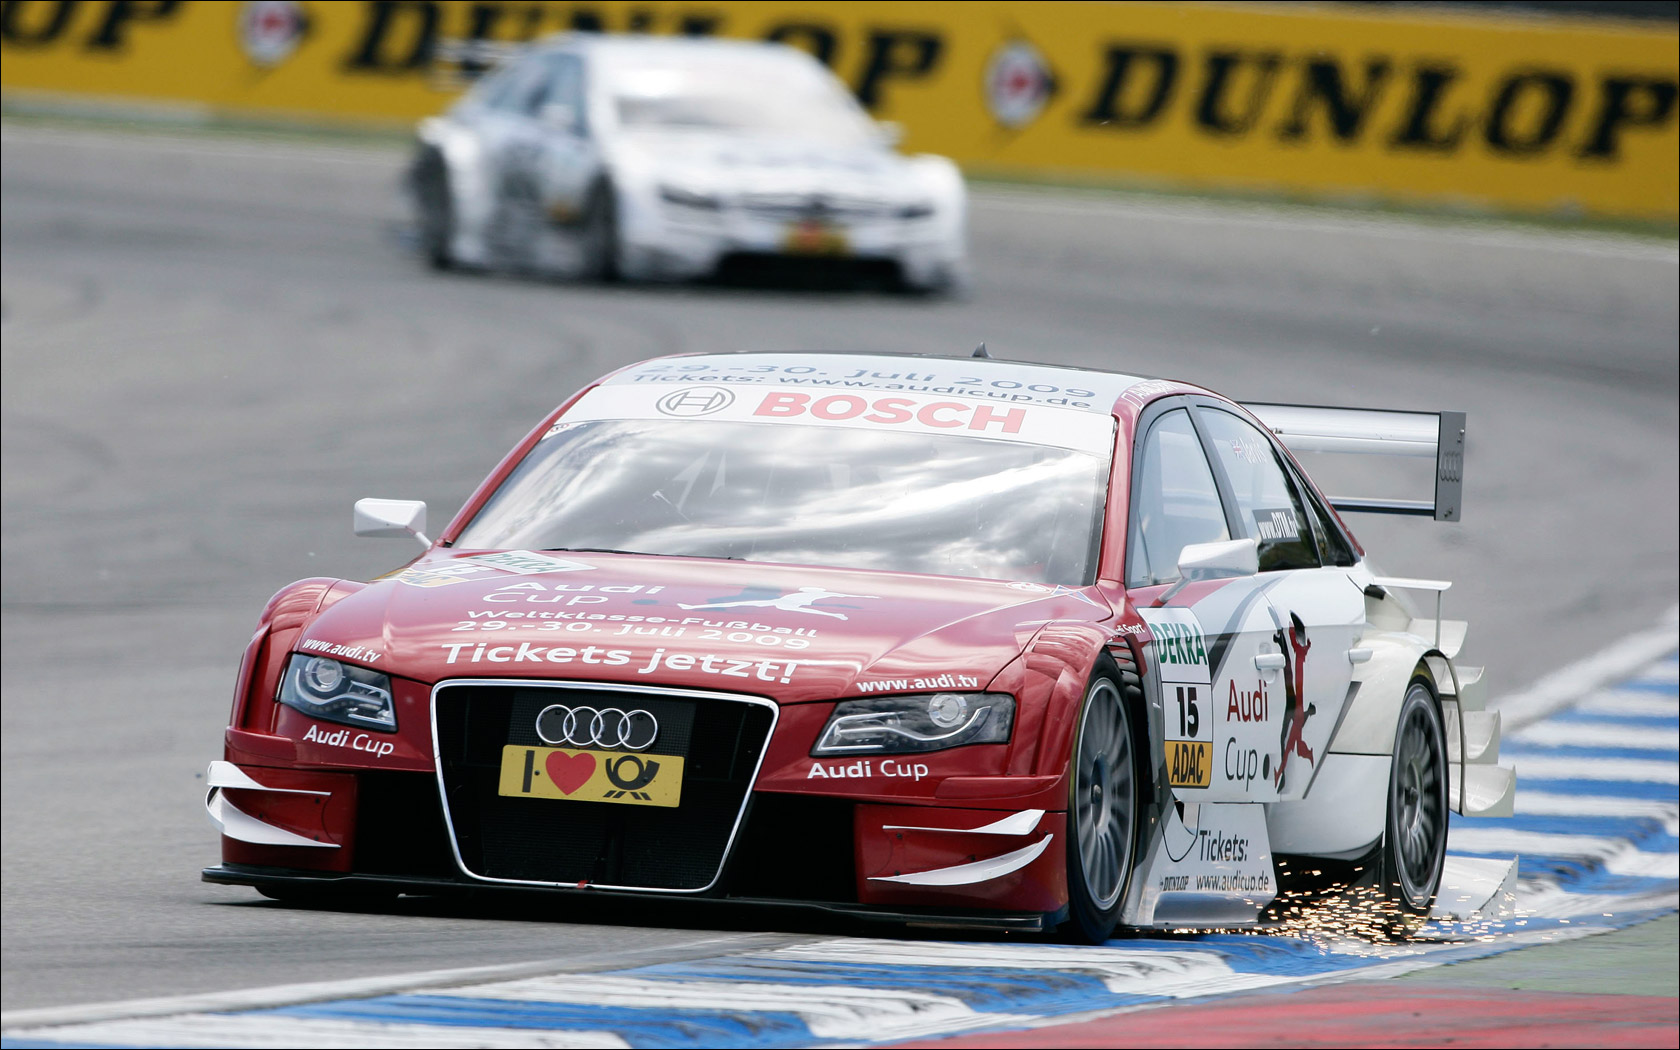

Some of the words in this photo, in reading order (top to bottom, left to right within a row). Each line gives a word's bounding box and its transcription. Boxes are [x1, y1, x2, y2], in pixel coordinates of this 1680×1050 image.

[1078, 42, 1679, 162] DUNLOP
[633, 374, 766, 383] Tickets:
[779, 377, 1091, 409] www.audicup.de
[641, 364, 827, 375] 29.-30.
[846, 368, 936, 382] Juli
[954, 376, 1096, 398] 2009
[752, 391, 1026, 434] BOSCH
[482, 592, 609, 606] Cup
[495, 582, 664, 594] Audi
[451, 620, 602, 632] 29.-30.
[612, 623, 686, 638] Juli
[697, 629, 810, 650] 2009
[467, 610, 817, 638] Weltklasse-Fußball
[302, 639, 382, 663] www.audi.tv
[1149, 622, 1208, 666] DEKRA
[440, 642, 632, 665] Tickets
[637, 648, 798, 684] jetzt!
[857, 674, 978, 693] www.audi.tv
[1176, 687, 1199, 738] 15
[1226, 679, 1268, 722] Audi
[303, 725, 350, 748] Audi
[352, 733, 395, 758] Cup
[807, 761, 872, 779] Audi
[880, 760, 929, 781] Cup
[1170, 744, 1204, 784] ADAC
[1224, 737, 1258, 792] Cup
[1199, 830, 1249, 862] Tickets:
[1163, 875, 1190, 892] DUNLOP
[1196, 869, 1269, 894] www.audicup.de
